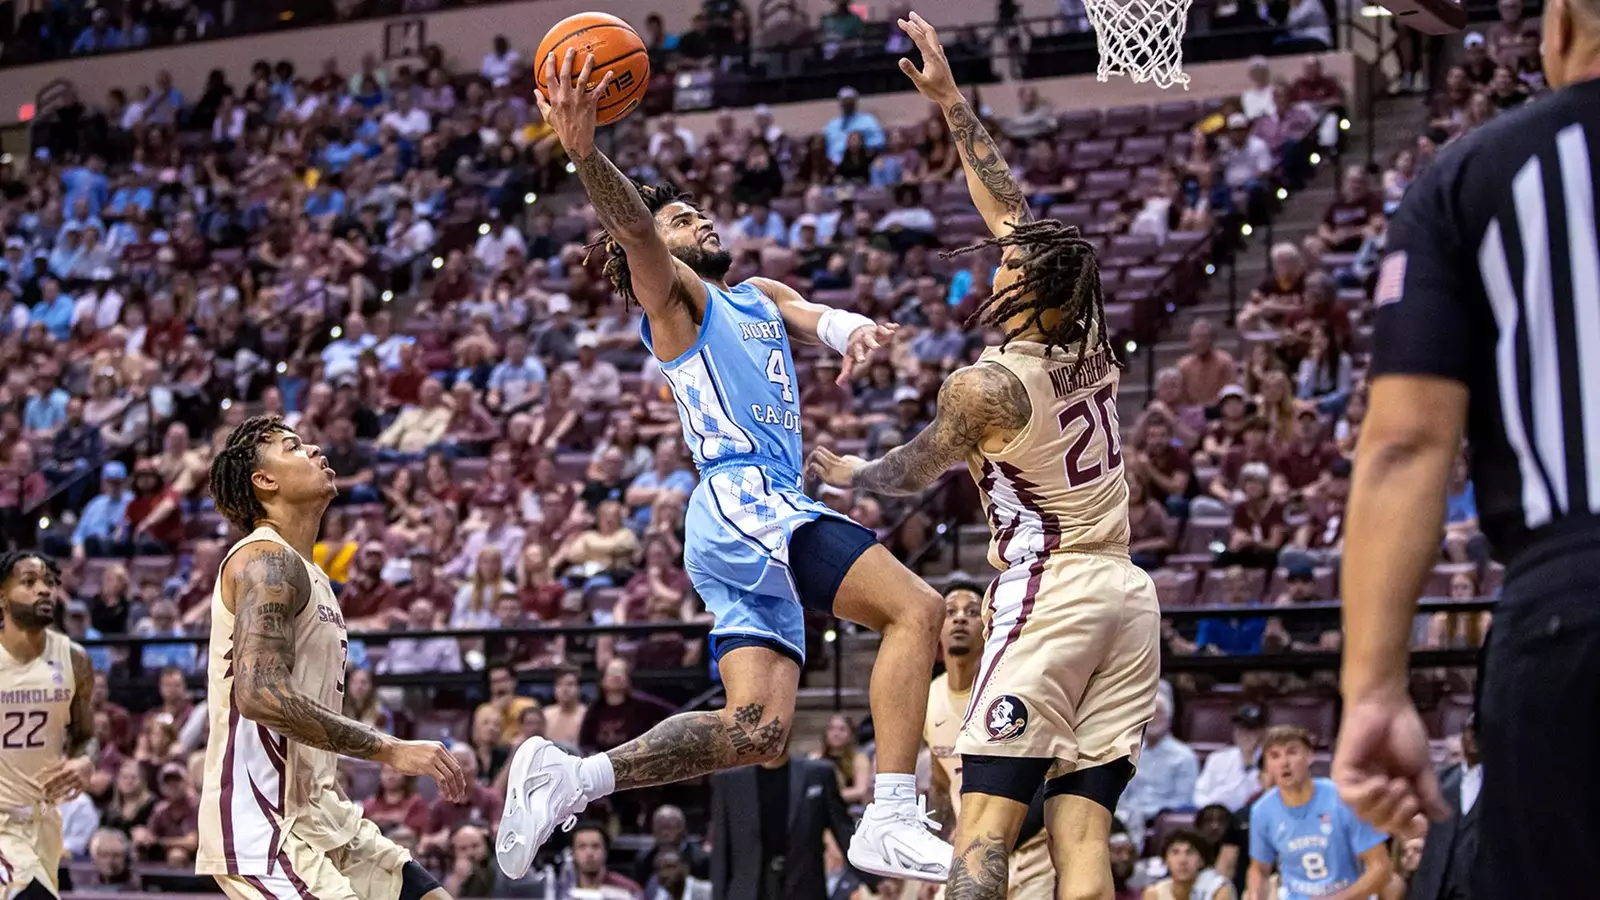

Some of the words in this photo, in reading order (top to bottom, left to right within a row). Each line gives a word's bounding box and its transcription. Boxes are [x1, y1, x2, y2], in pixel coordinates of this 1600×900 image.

[598, 70, 634, 100] ELI
[765, 348, 795, 404] 4
[1056, 382, 1124, 489] 20
[3, 711, 48, 749] 22
[726, 721, 756, 756] TMC
[1301, 852, 1329, 880] 8
